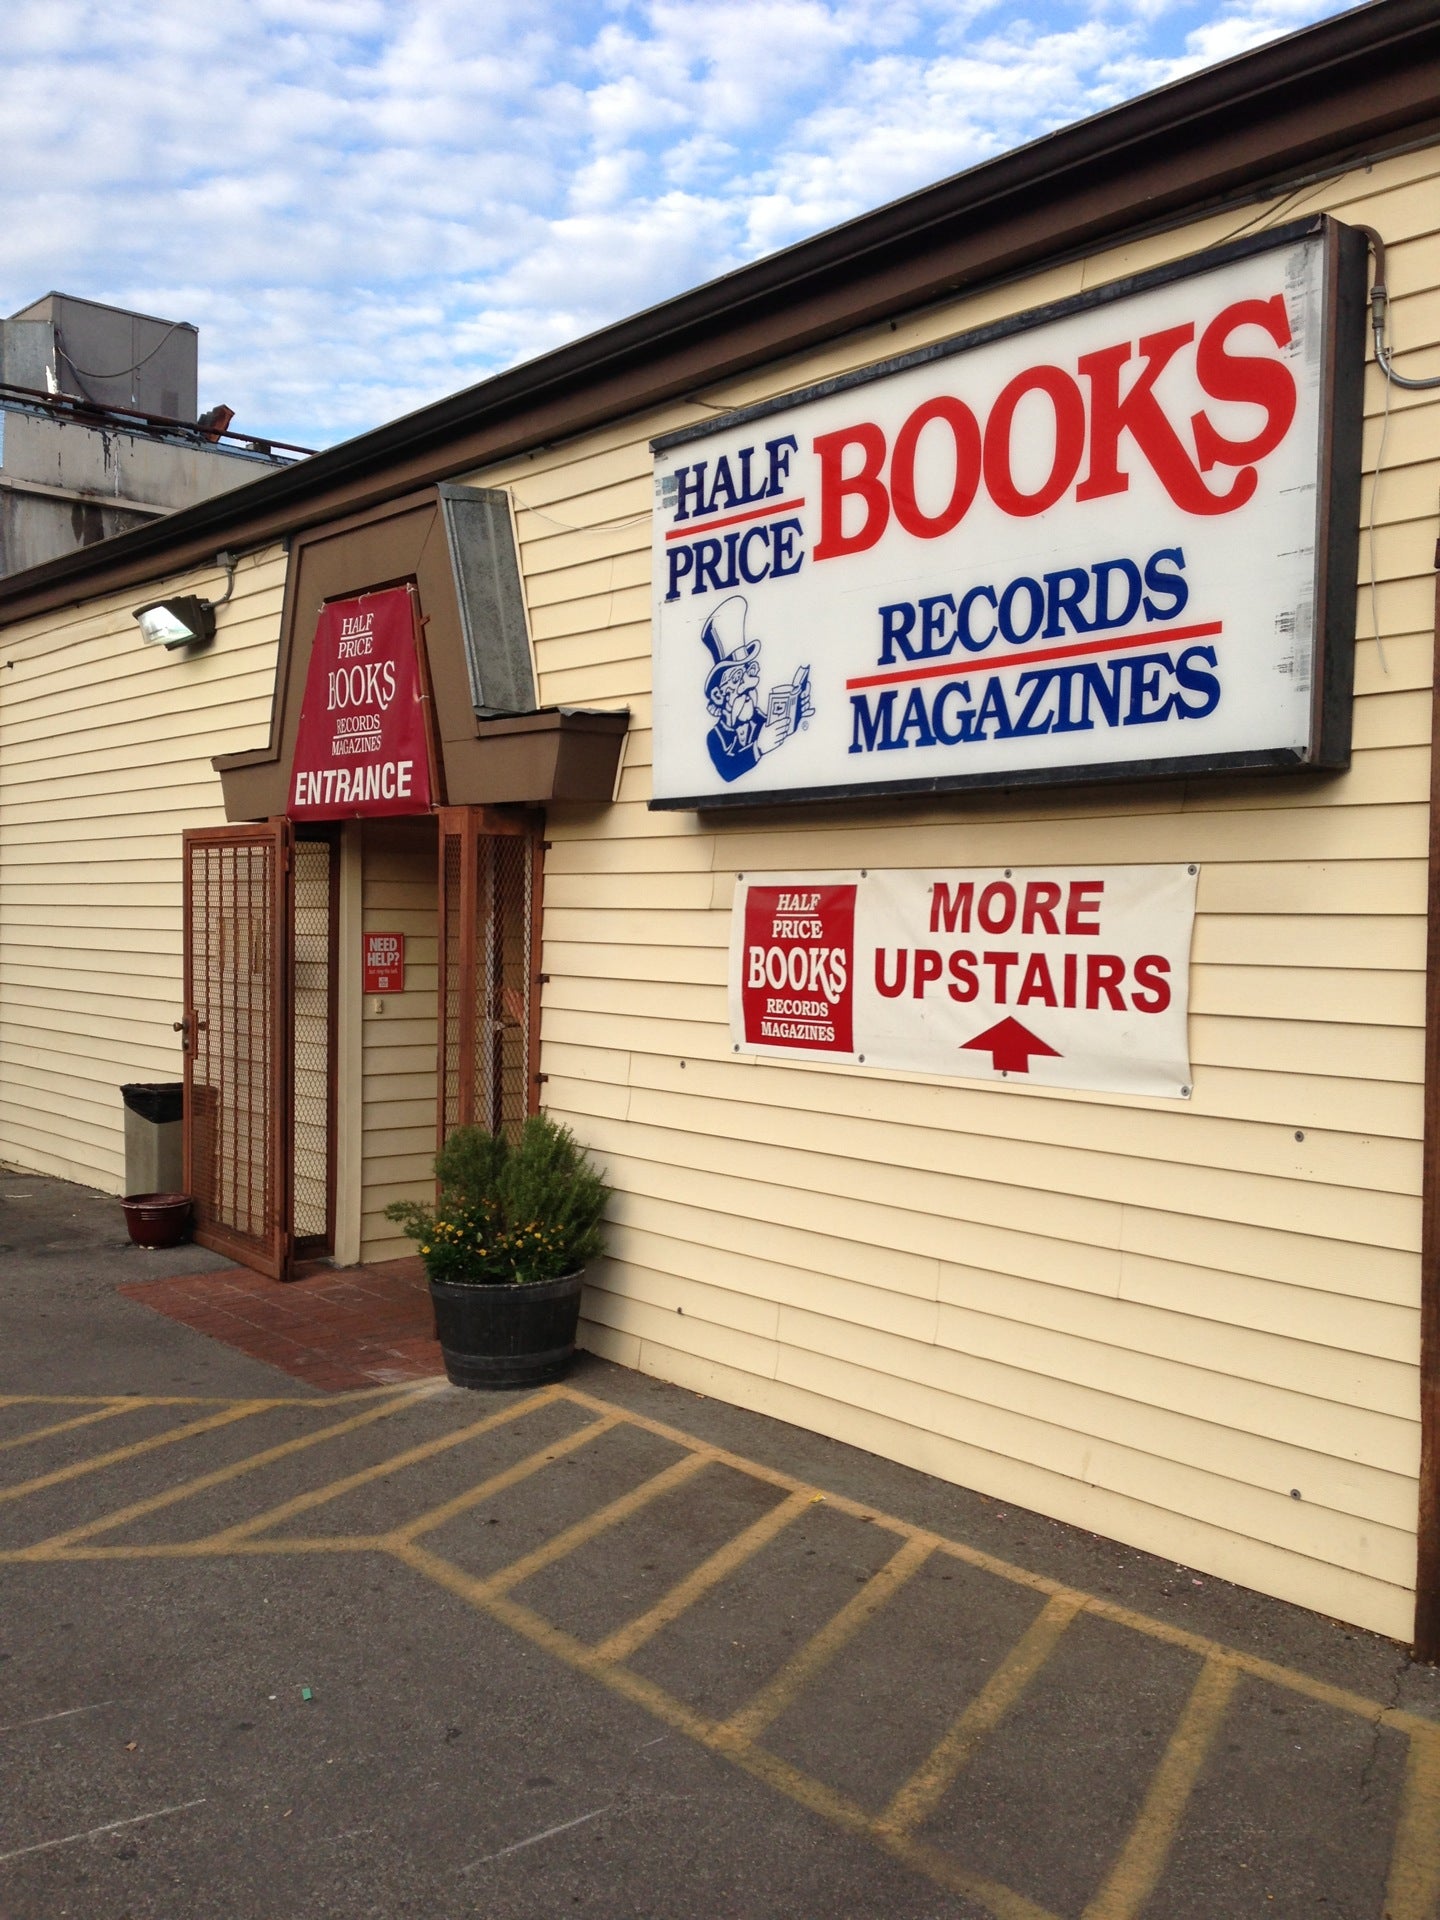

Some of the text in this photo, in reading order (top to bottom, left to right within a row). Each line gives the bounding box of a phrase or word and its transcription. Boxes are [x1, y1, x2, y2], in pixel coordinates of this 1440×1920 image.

[812, 293, 1298, 563] BOOKS
[673, 434, 798, 522] HALF
[665, 518, 804, 601] PRICE
[341, 612, 374, 636] HALF
[877, 547, 1190, 666] RECORDS
[337, 636, 373, 659] PRICE
[326, 660, 396, 711] BOOKS
[847, 644, 1222, 755] MAGAZINES
[335, 713, 381, 735] RECORDS
[331, 735, 382, 756] MAGAZINES
[294, 760, 413, 806] ENTRANCE
[777, 893, 821, 911] HALF
[929, 880, 1105, 936] MORE
[369, 937, 398, 952] NEED
[772, 919, 823, 939] PRICE
[367, 952, 400, 967] HELP?
[747, 945, 847, 1004] BOOKS
[874, 948, 1172, 1014] UPSTAIRS
[766, 998, 829, 1018] RECORDS
[761, 1021, 835, 1042] MAGAZINES
